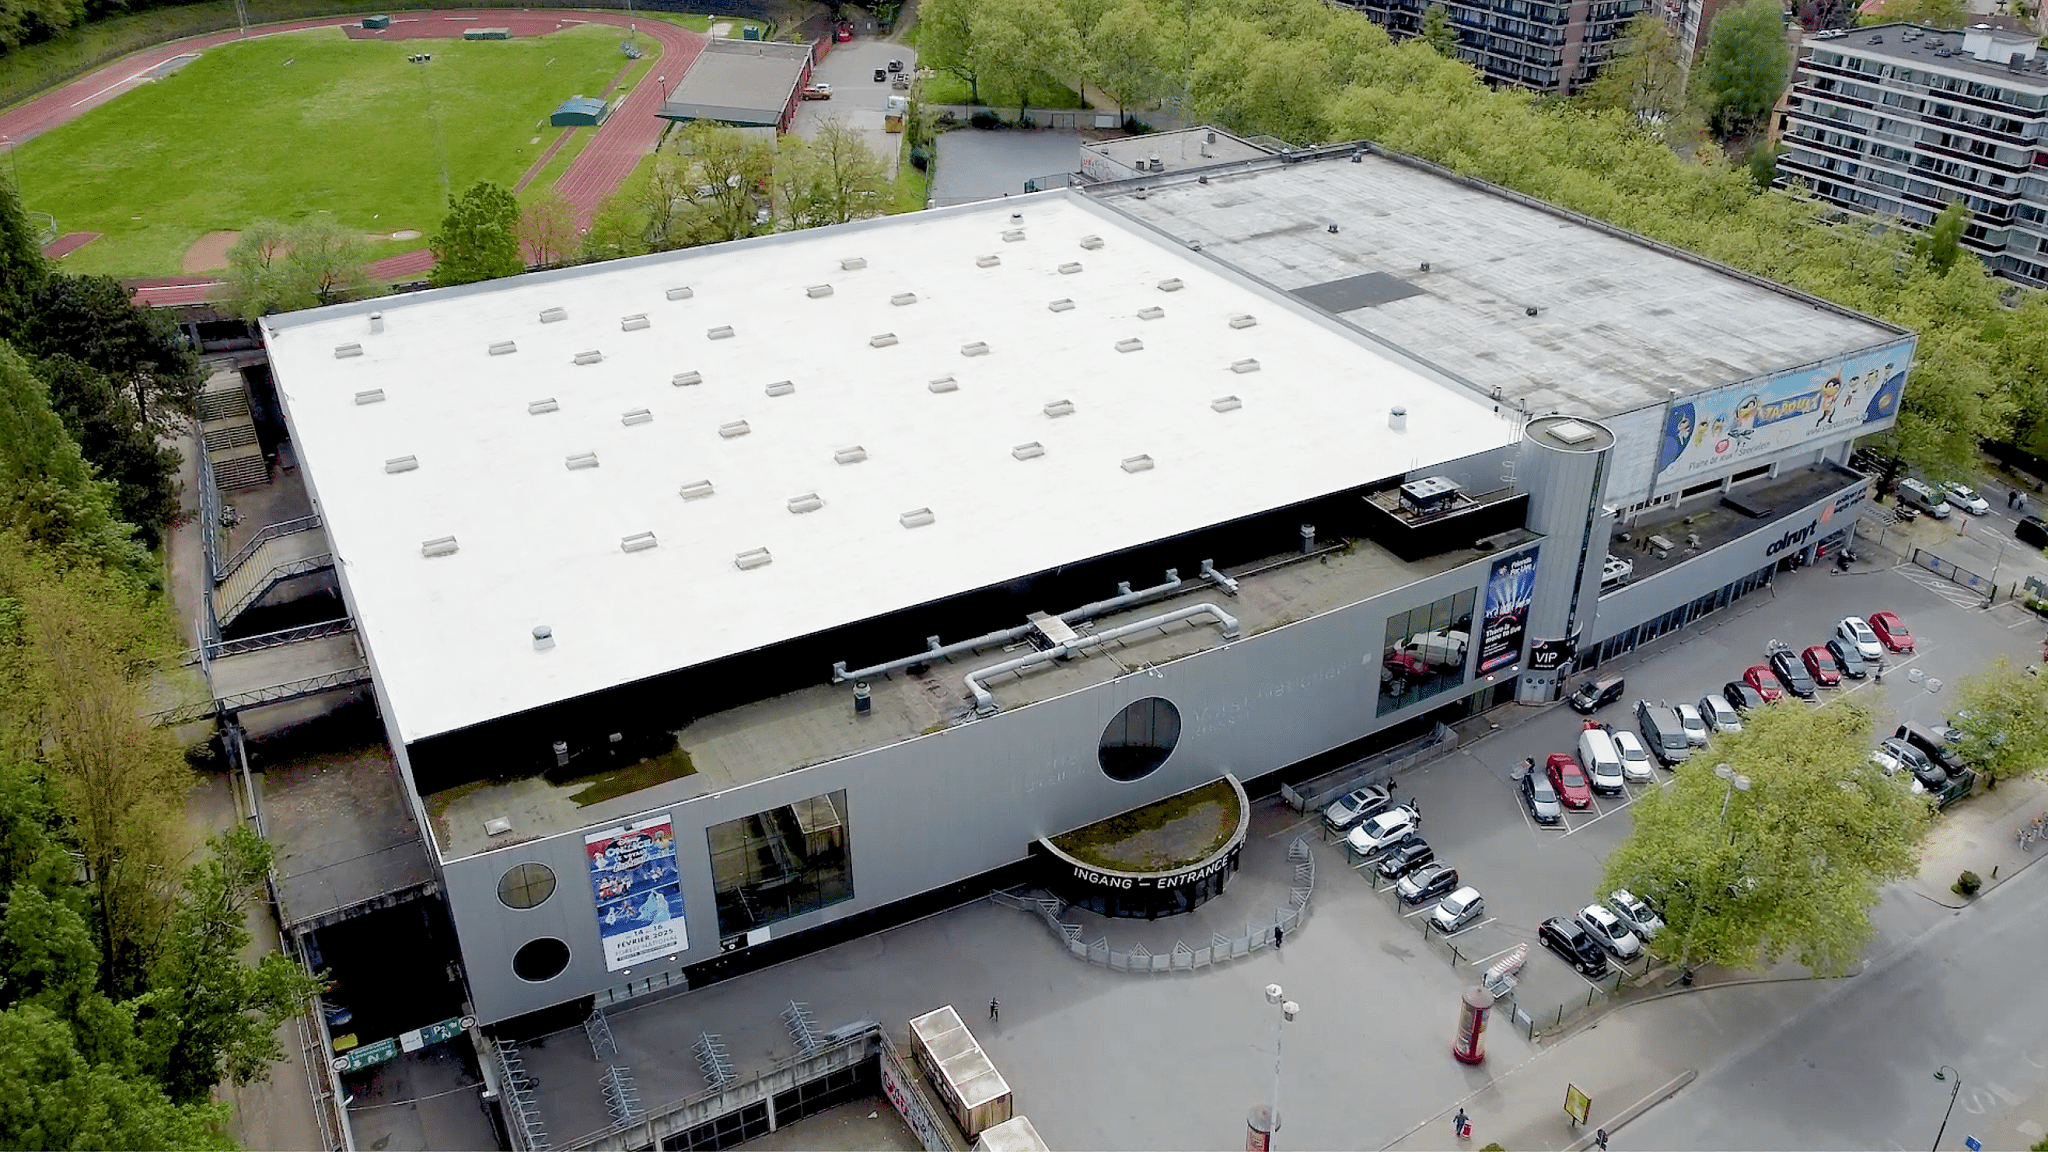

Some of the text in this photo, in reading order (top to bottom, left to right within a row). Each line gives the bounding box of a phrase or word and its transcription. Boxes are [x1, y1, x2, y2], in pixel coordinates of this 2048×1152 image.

[1766, 518, 1818, 557] colruyt
[1535, 651, 1558, 663] VIP
[1073, 866, 1133, 890] INGANG
[1157, 854, 1229, 890] ENTRANCE
[653, 928, 673, 939] 2025
